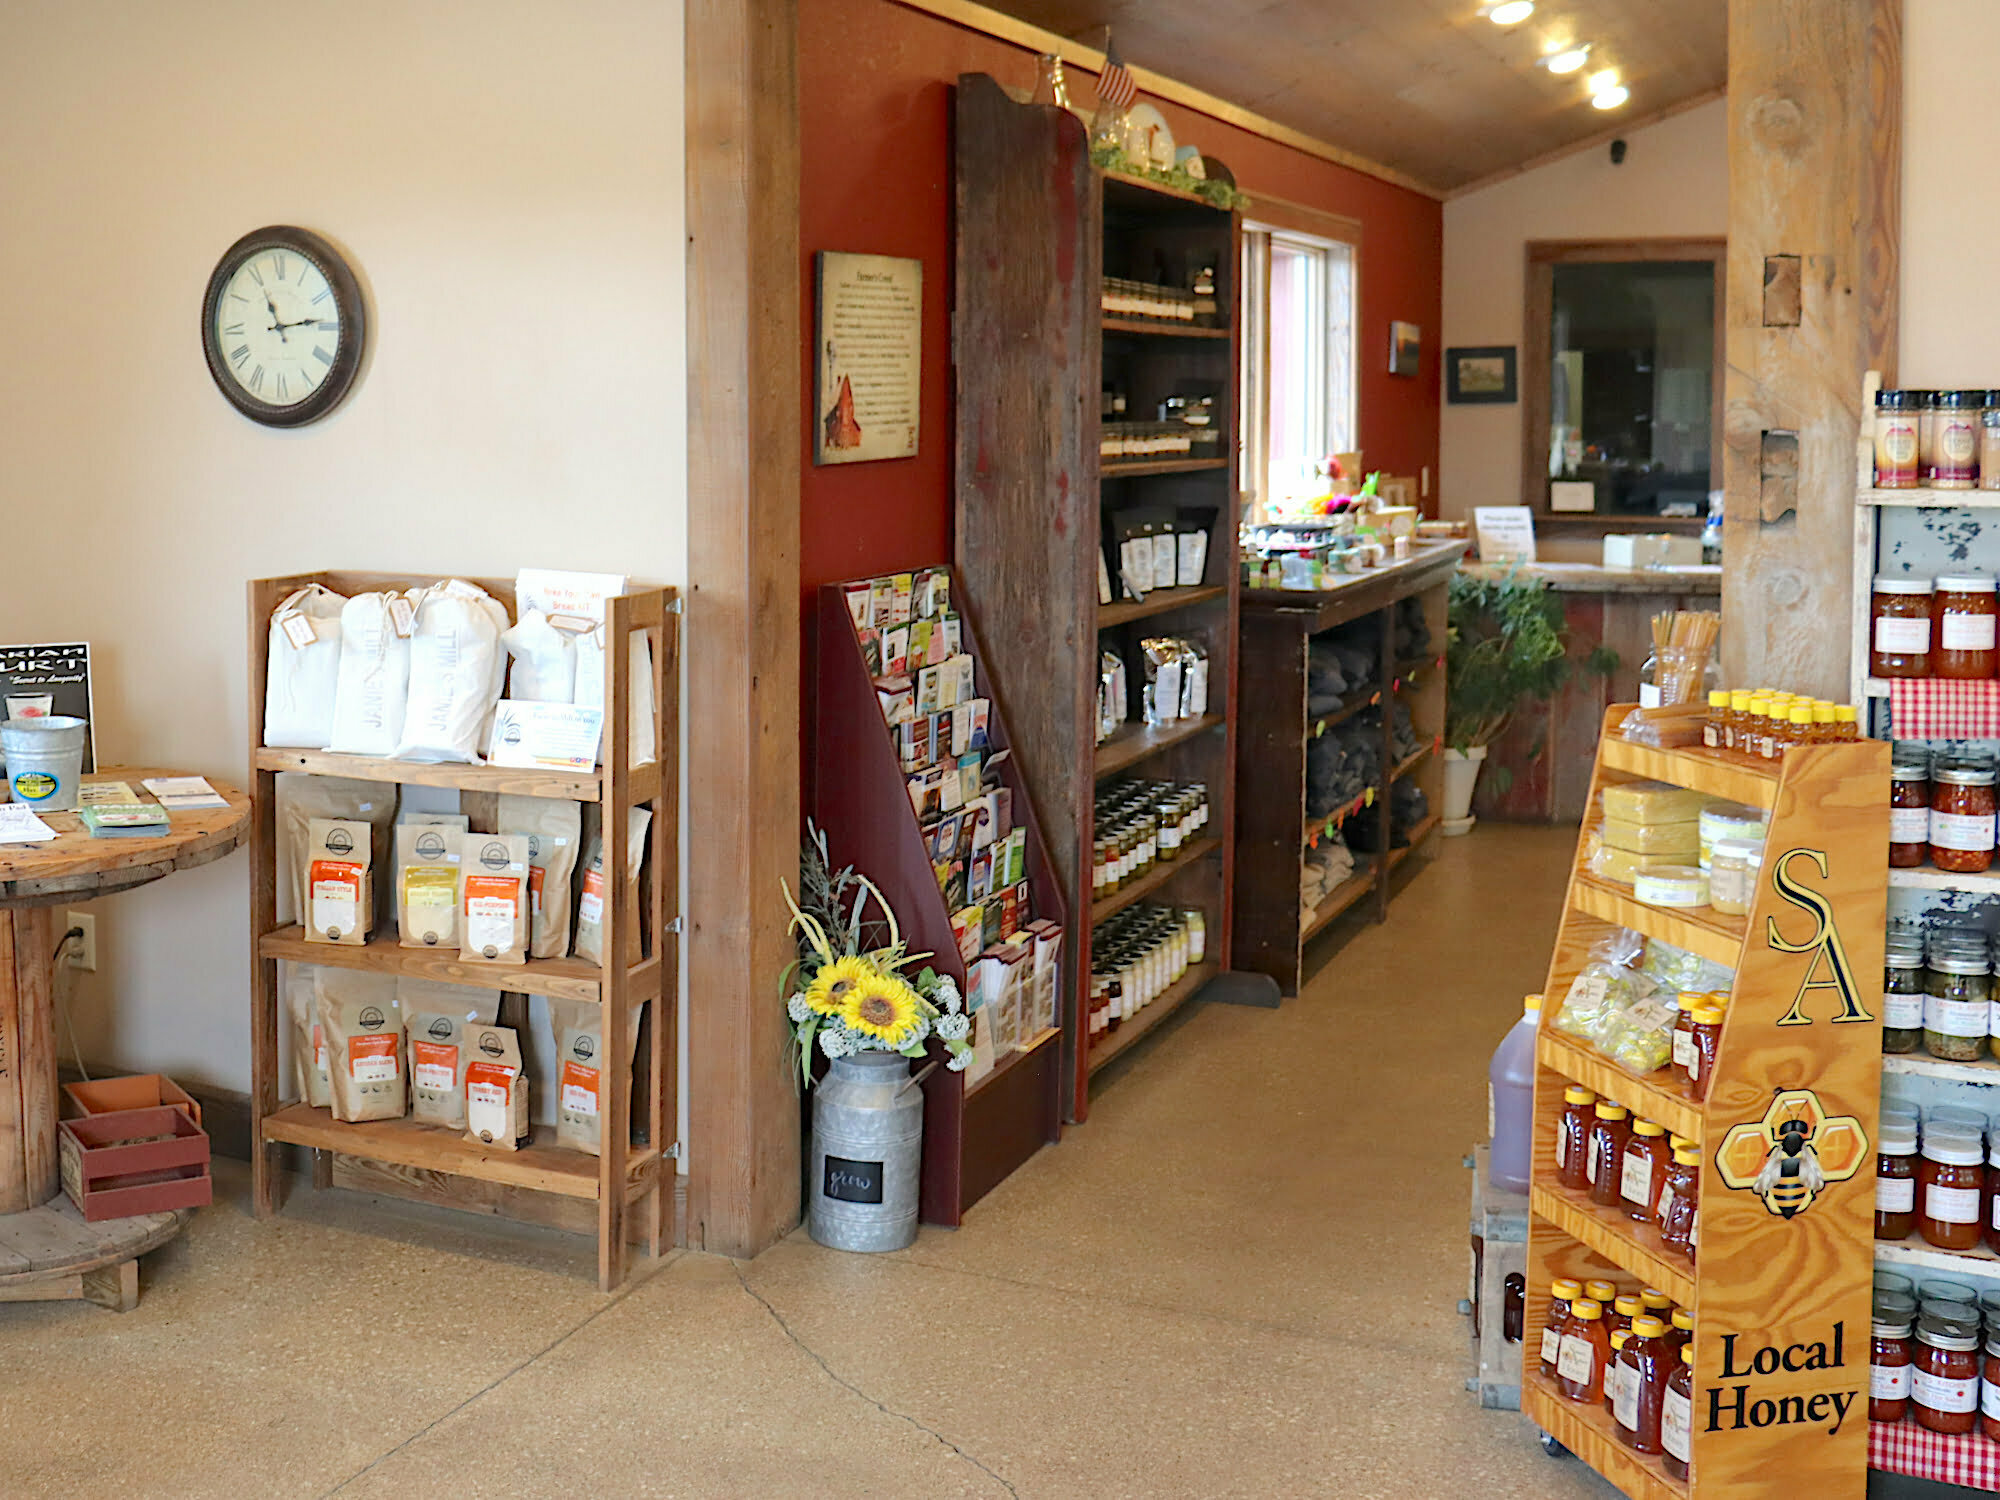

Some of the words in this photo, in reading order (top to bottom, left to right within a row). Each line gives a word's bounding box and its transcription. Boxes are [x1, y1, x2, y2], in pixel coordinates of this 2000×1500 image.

[0, 647, 85, 659] RIAN
[1719, 1321, 1845, 1380] Local
[1705, 1384, 1859, 1436] Honey
